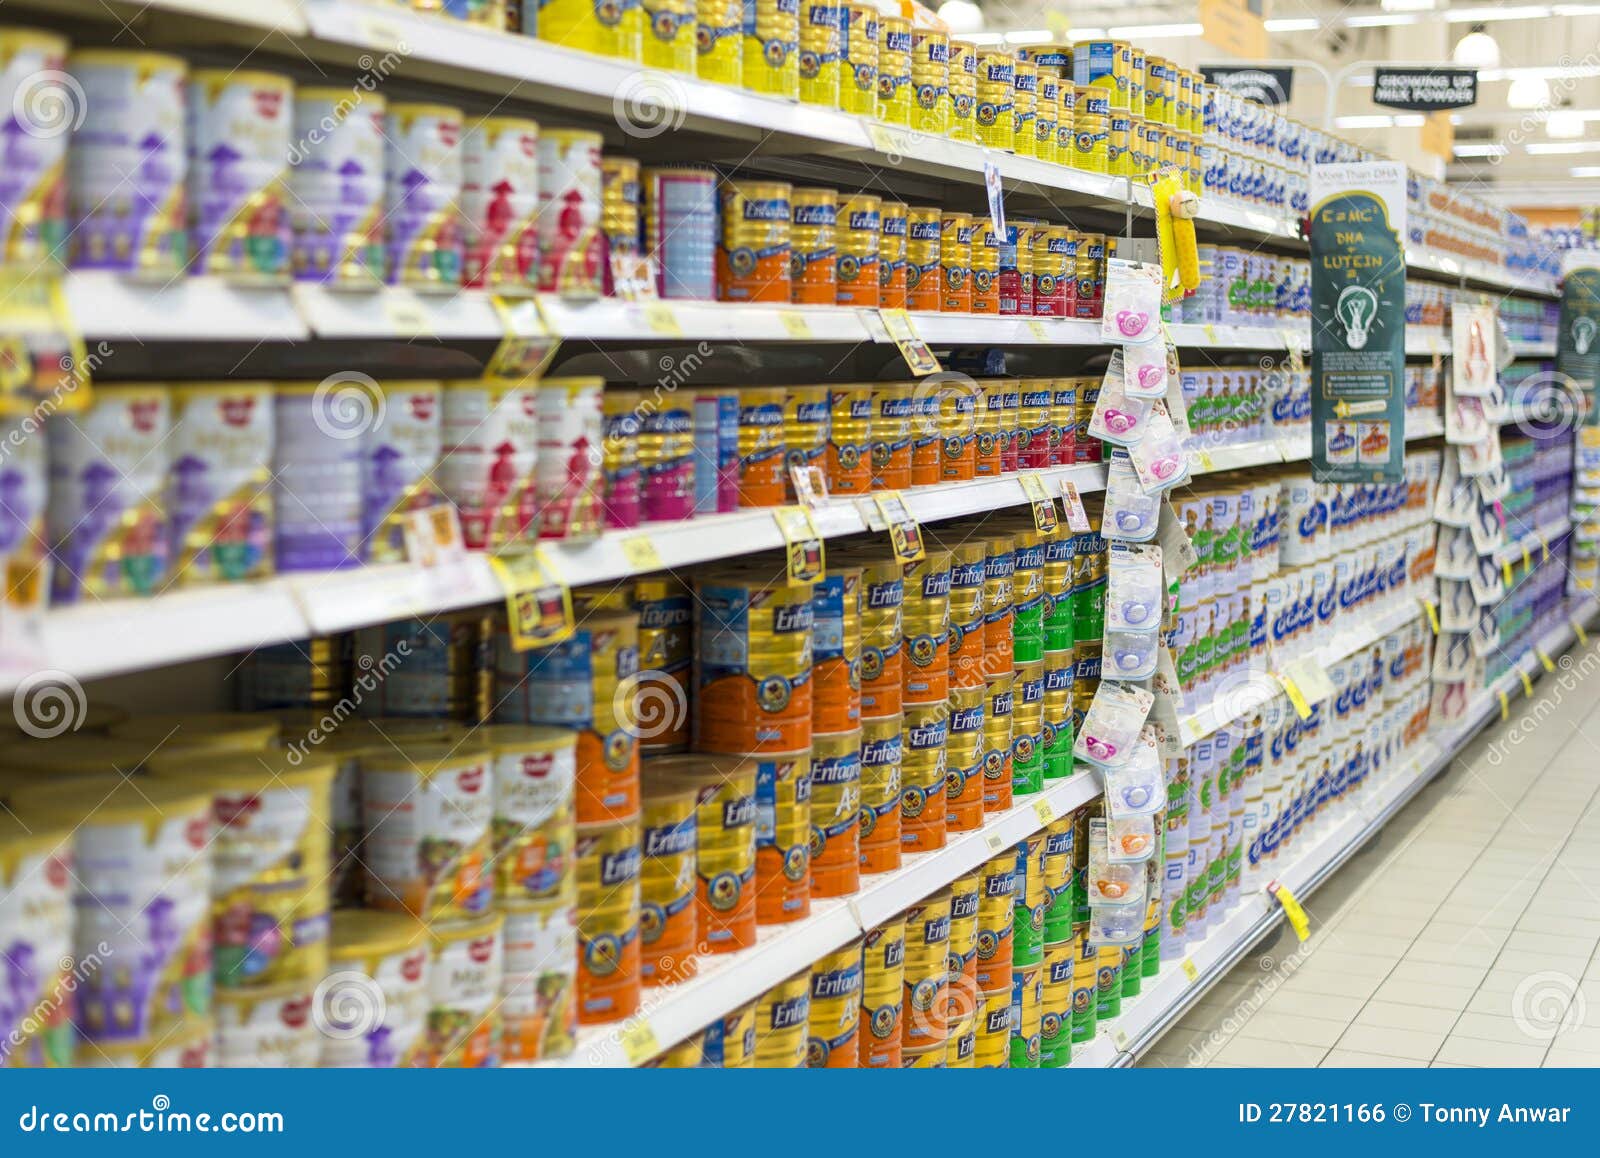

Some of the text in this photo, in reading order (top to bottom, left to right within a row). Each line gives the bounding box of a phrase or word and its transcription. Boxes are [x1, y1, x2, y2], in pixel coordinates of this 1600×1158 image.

[1378, 75, 1473, 88] GROWING UP
[1376, 89, 1473, 103] MILK POWDER
[1335, 231, 1365, 245] DHA
[1323, 255, 1383, 269] LUTEIN
[1078, 557, 1100, 579] A+
